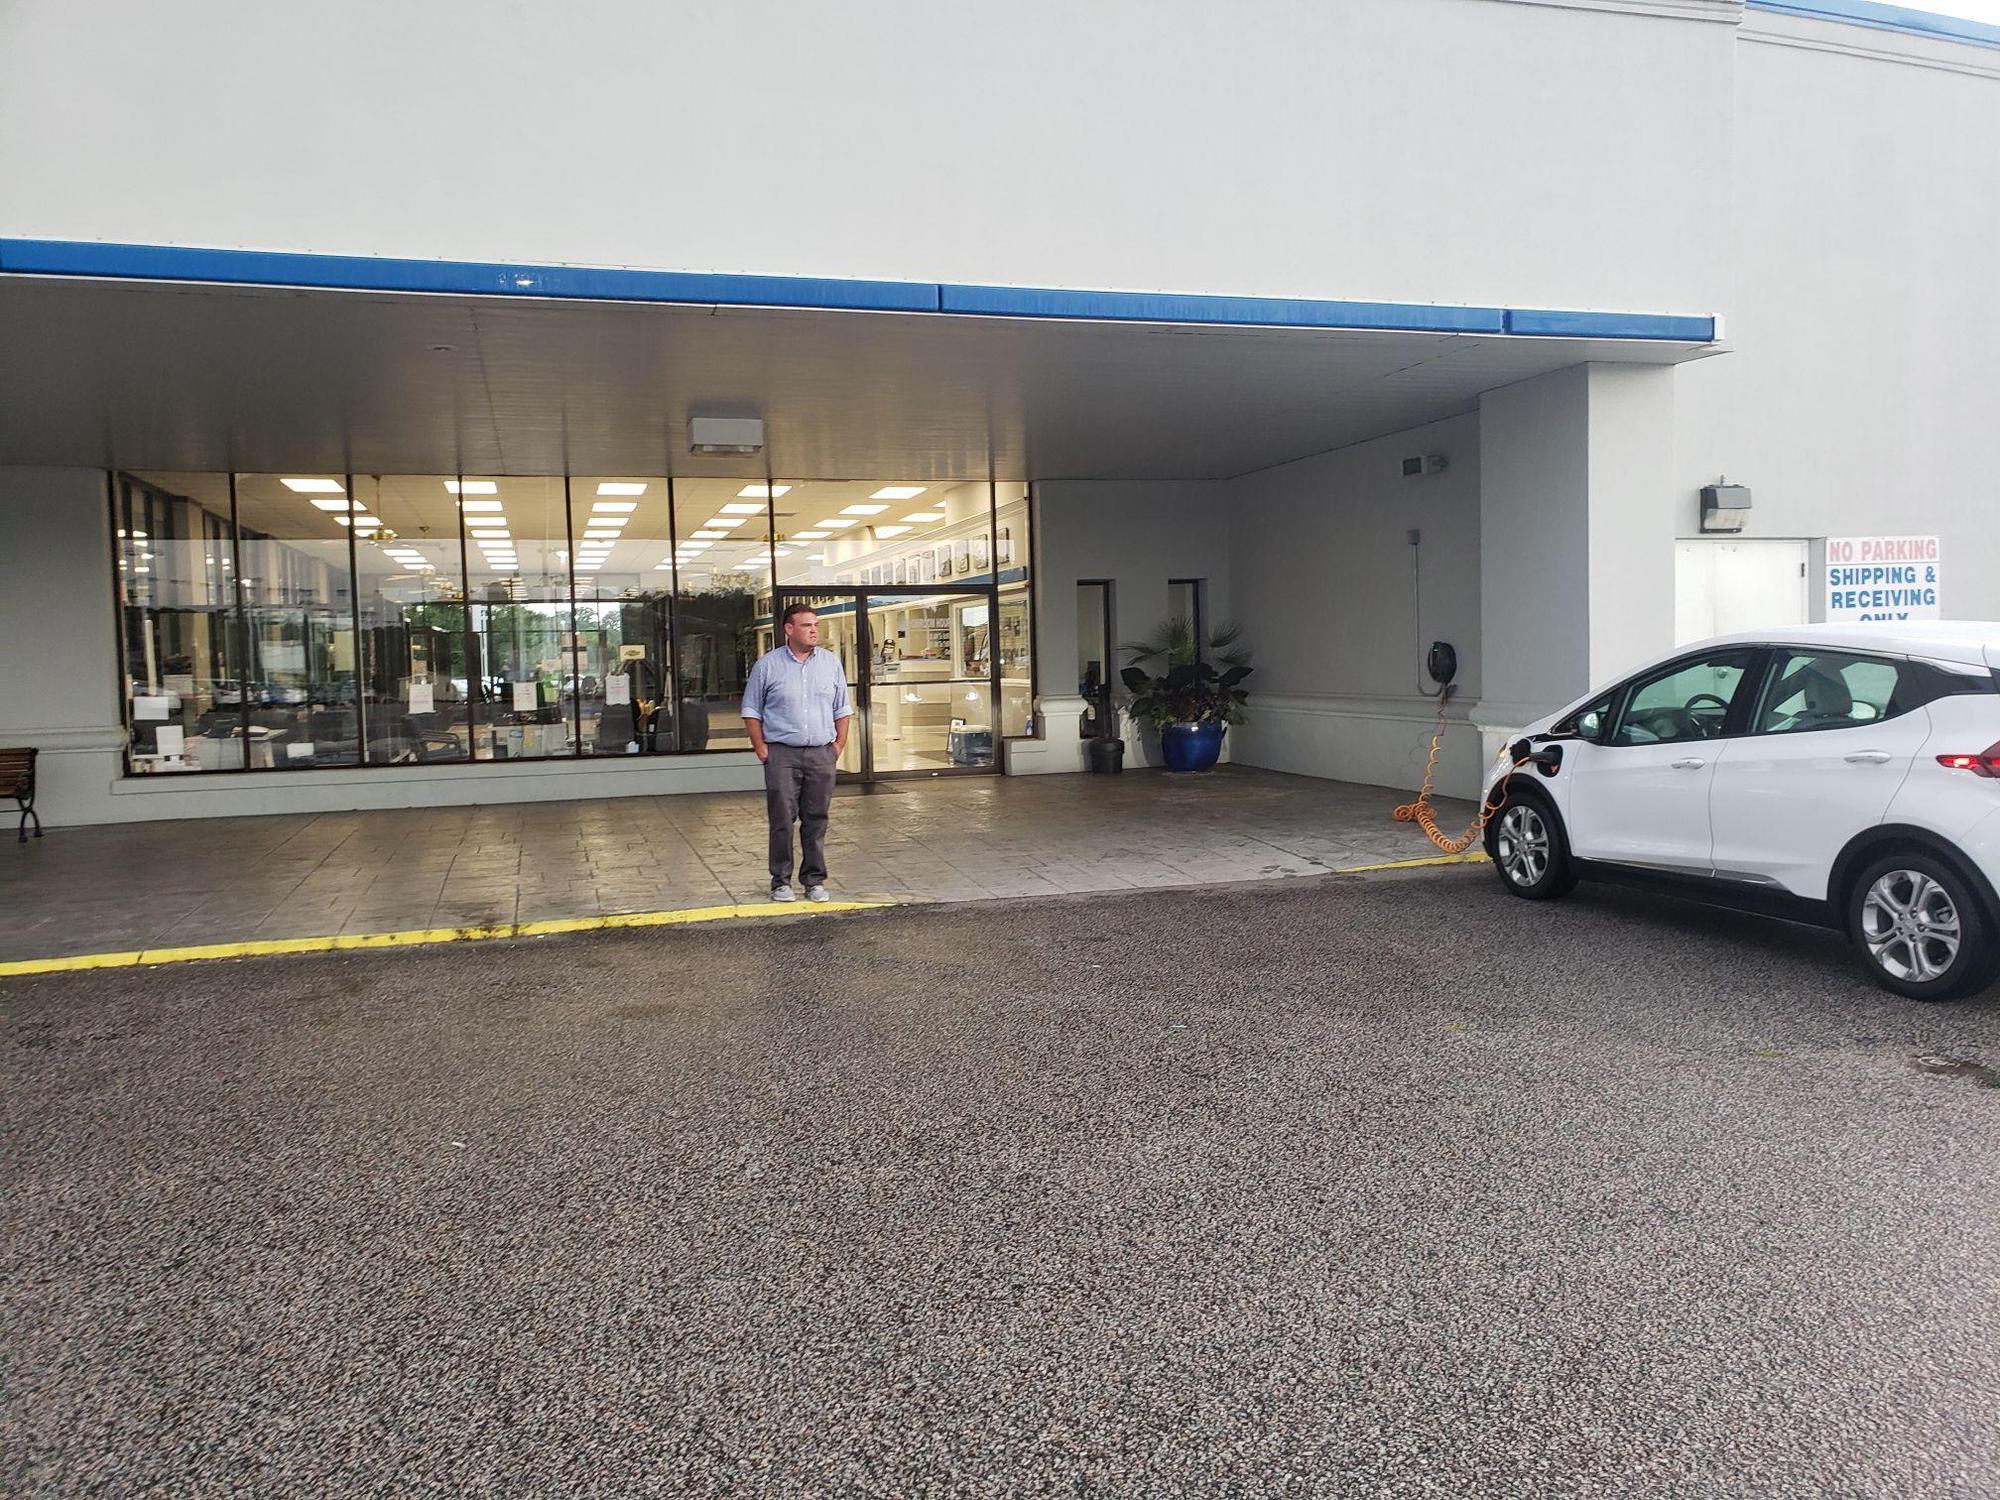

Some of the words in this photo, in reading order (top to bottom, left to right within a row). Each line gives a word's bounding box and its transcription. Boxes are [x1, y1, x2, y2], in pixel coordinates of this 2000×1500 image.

[1829, 542, 1853, 562] NO
[1861, 539, 1937, 561] PARKING
[1830, 566, 1916, 586] SHIPPING
[1925, 565, 1936, 583] &
[1831, 588, 1936, 609] RECEIVING
